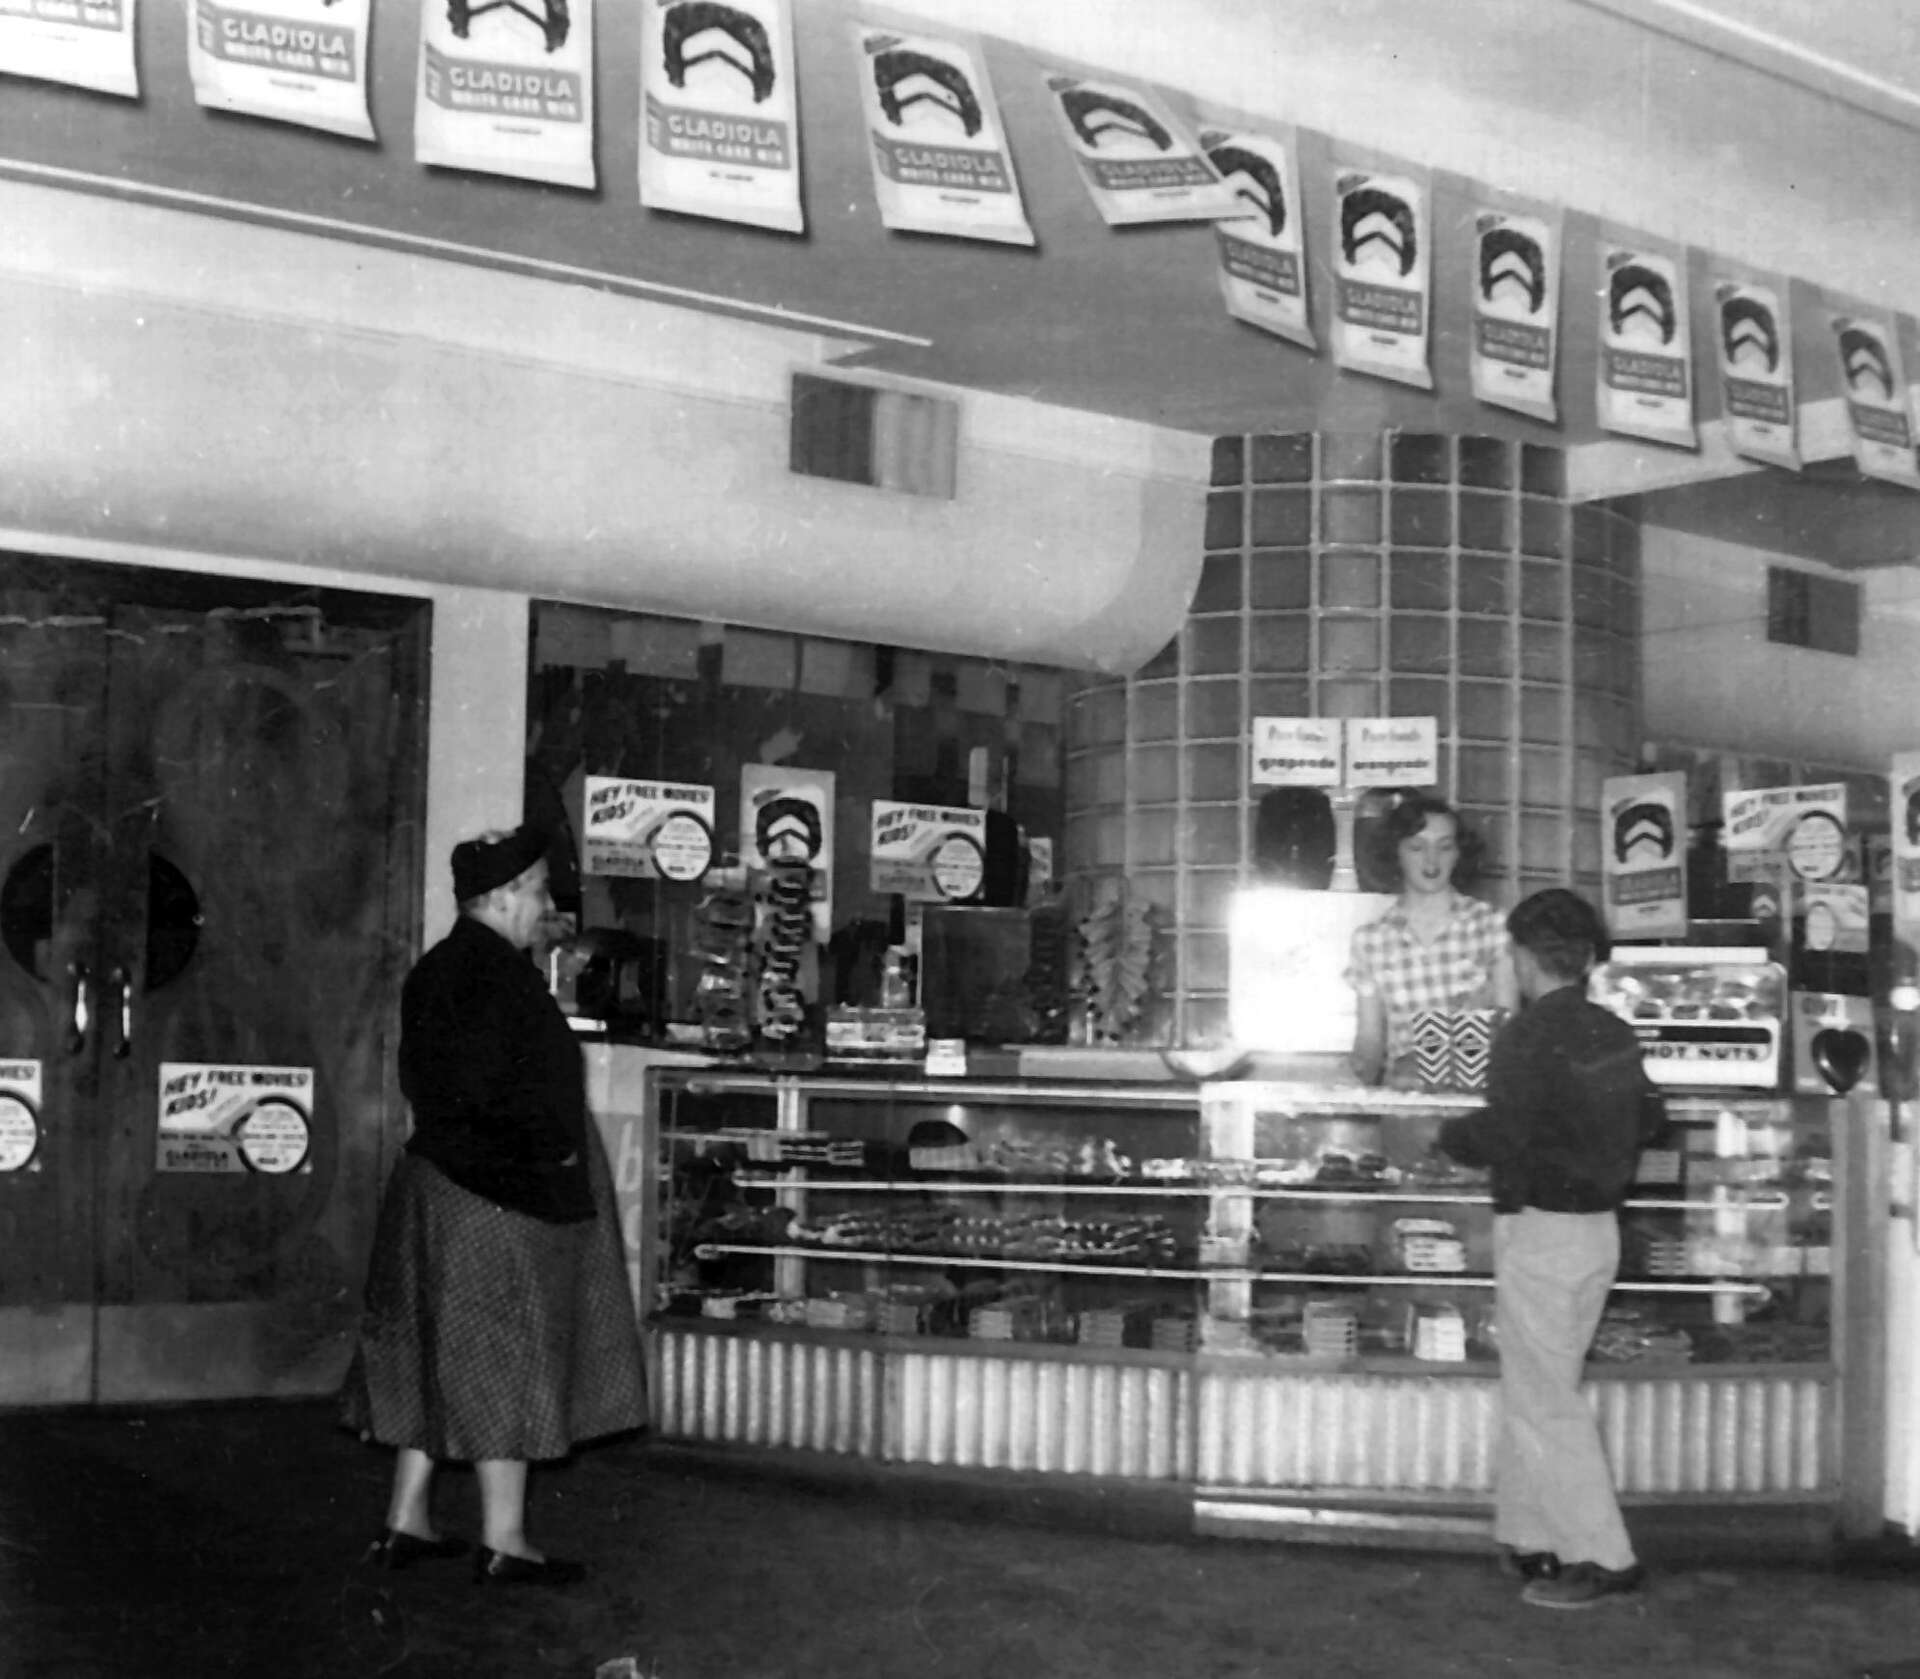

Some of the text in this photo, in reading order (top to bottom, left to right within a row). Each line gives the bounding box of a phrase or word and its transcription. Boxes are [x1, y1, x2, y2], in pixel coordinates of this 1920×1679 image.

[221, 17, 347, 56] GLADIOLA
[450, 66, 572, 98] GLADIOLA
[668, 115, 779, 146] GLADIOLA
[894, 147, 998, 173] GLADIOLA
[591, 784, 622, 805] HEY
[627, 784, 657, 799] FREE
[1698, 1046, 1759, 1060] NUTS
[165, 1071, 201, 1096] HEY
[207, 1070, 244, 1086] FREE
